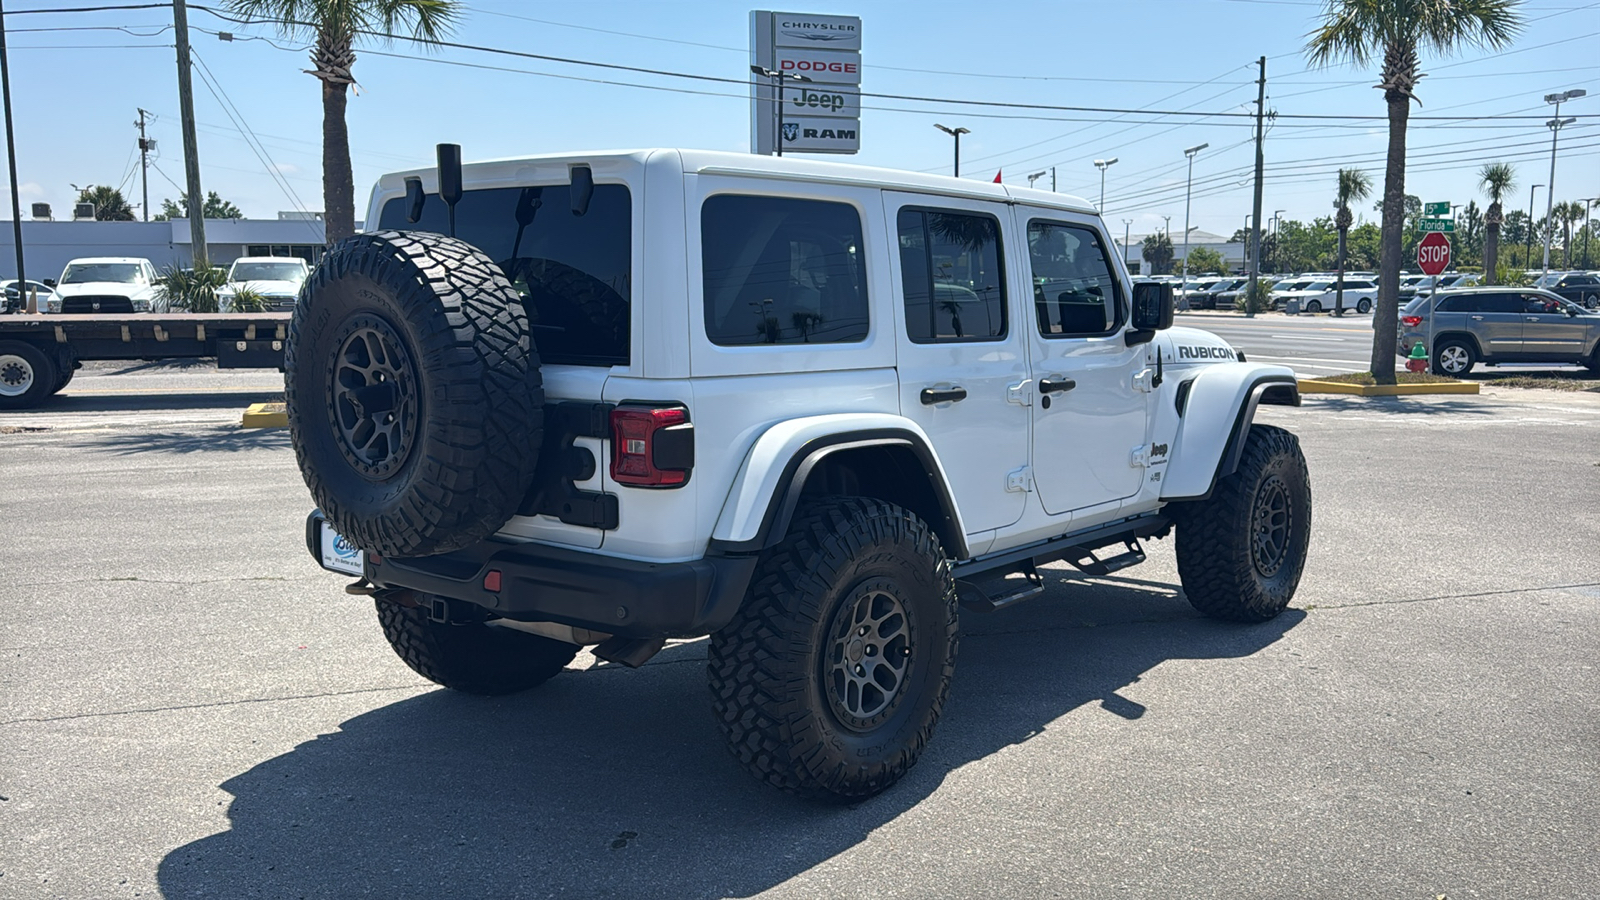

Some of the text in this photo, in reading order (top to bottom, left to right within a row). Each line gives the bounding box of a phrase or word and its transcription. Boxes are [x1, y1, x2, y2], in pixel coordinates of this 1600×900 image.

[782, 21, 855, 32] CHRYSLER
[781, 60, 857, 73] DODGE
[793, 88, 844, 112] Jeep
[803, 128, 856, 139] RAM
[1426, 203, 1438, 214] 15th
[1420, 220, 1445, 231] Florida
[1420, 245, 1448, 263] STOP
[1178, 346, 1235, 360] RUBICON
[1151, 442, 1168, 458] Jeep
